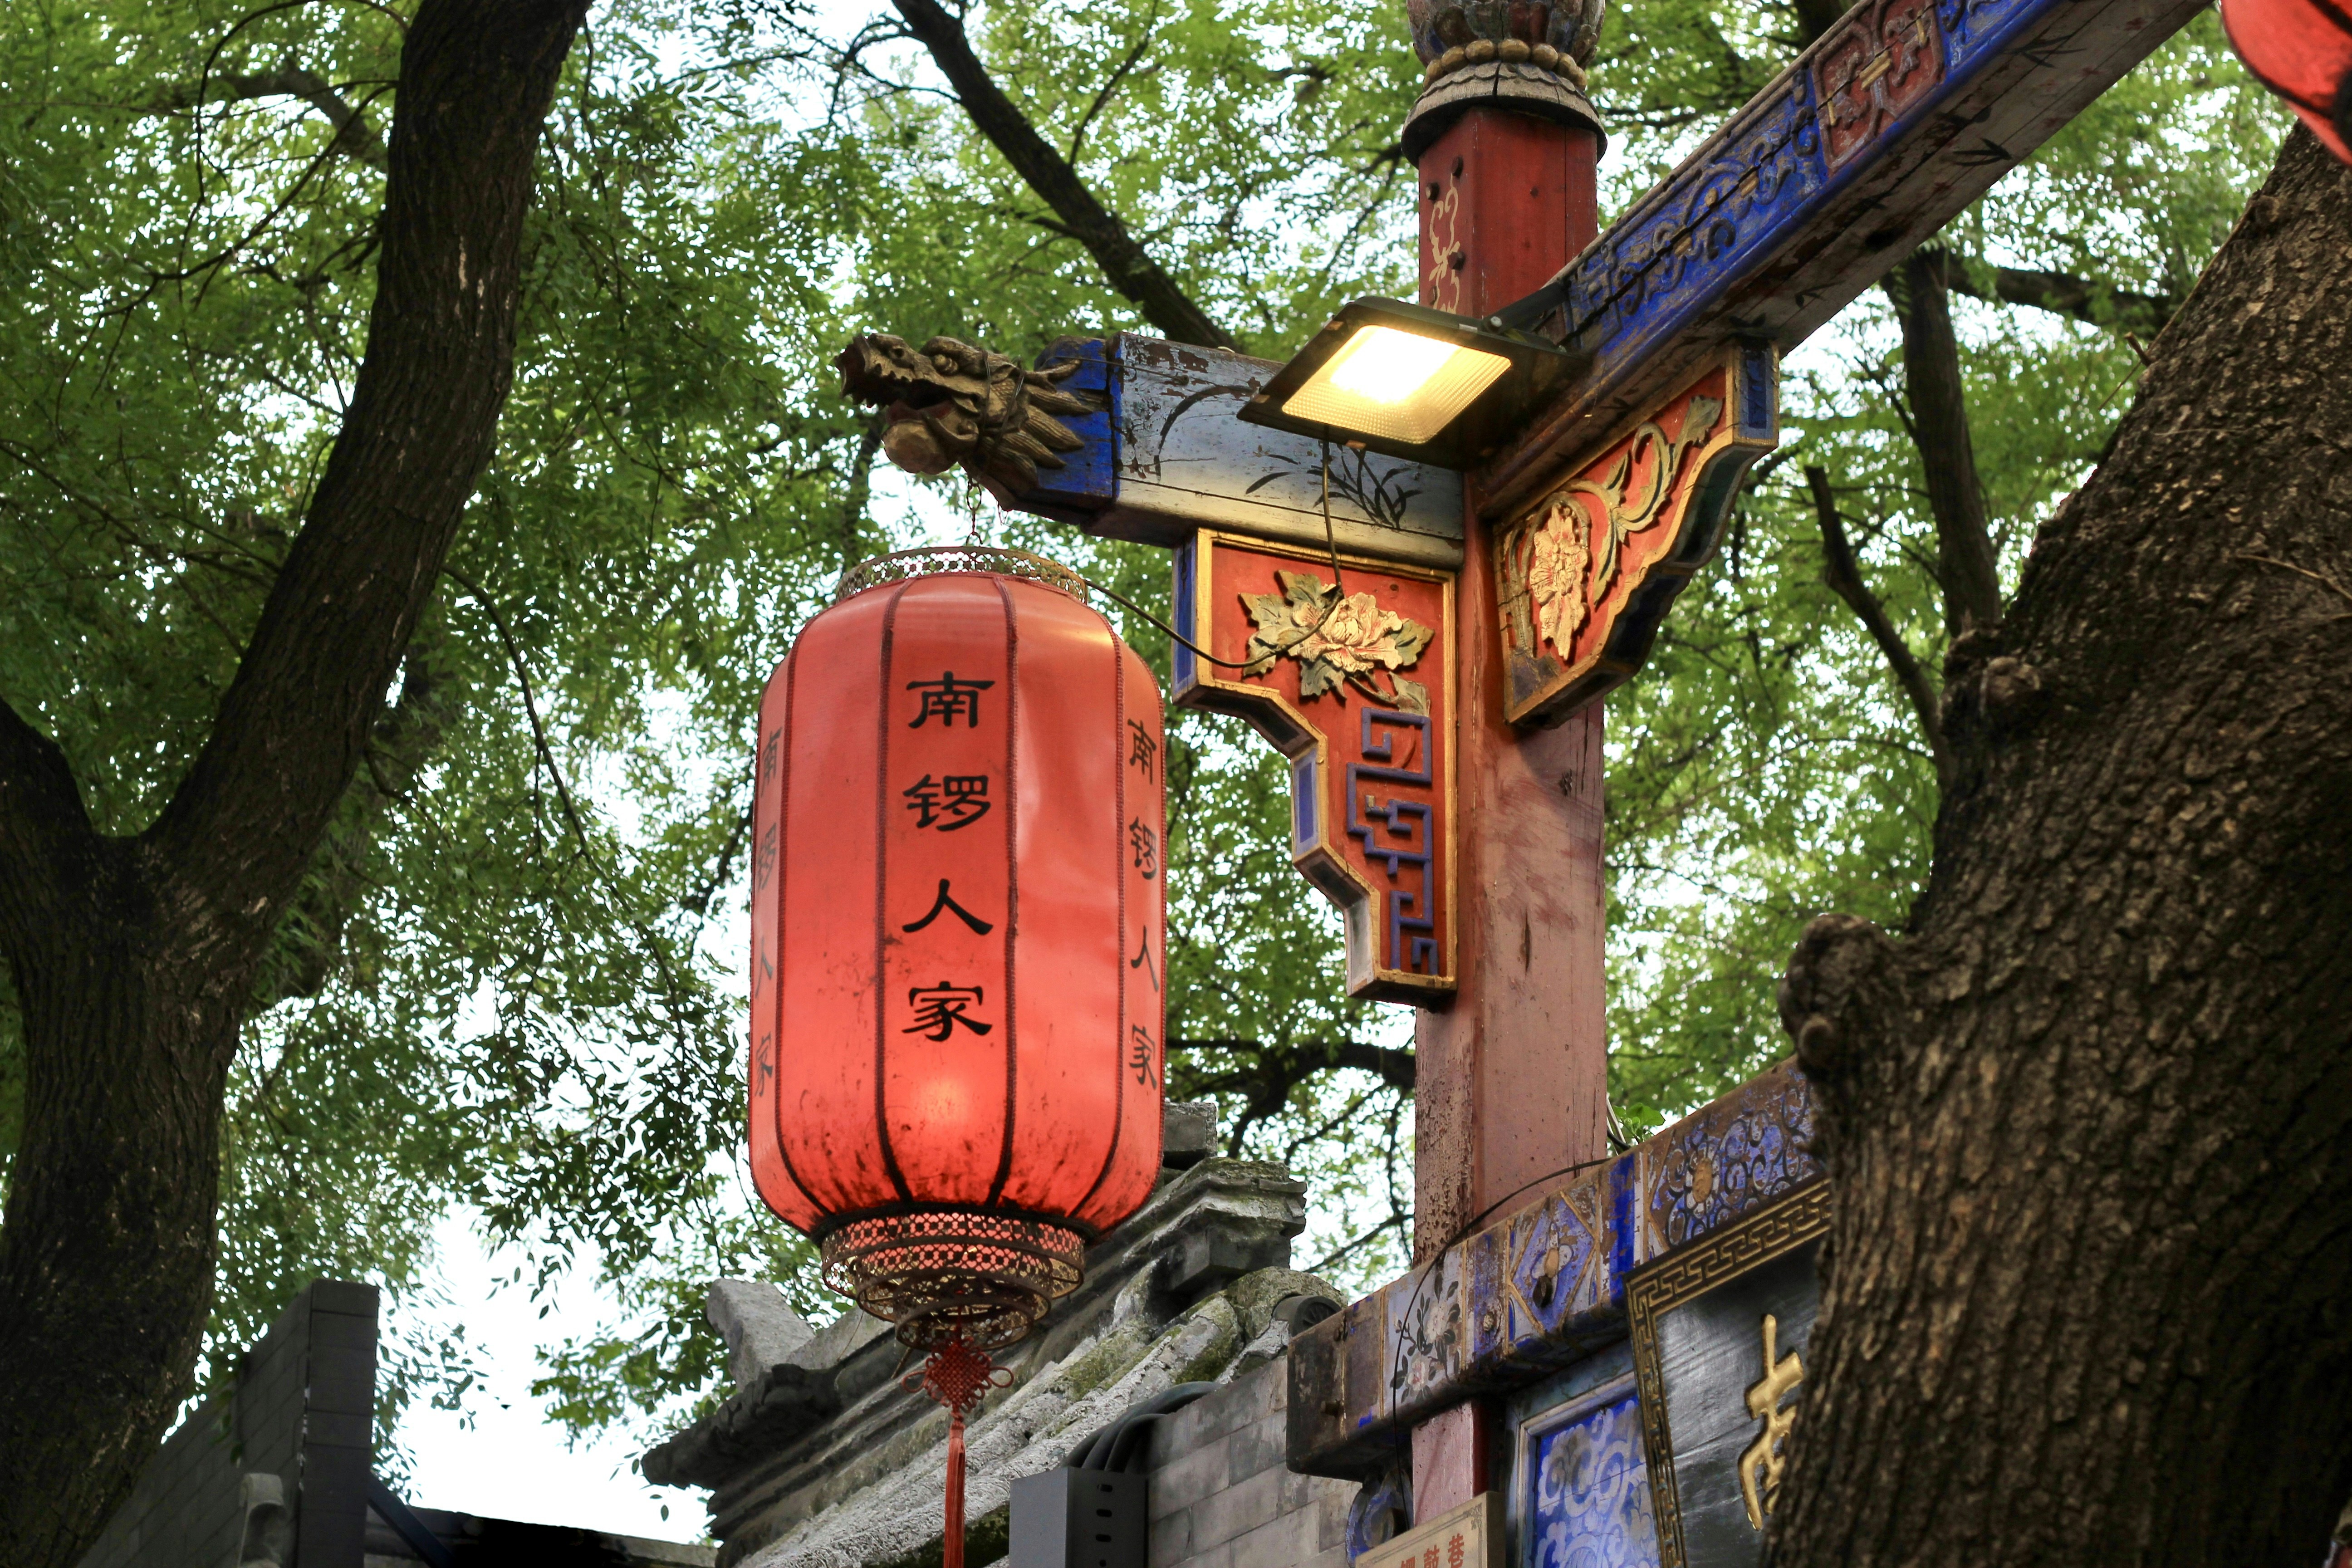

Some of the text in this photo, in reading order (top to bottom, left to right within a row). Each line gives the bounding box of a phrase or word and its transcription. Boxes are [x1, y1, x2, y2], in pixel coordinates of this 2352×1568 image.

[754, 727, 782, 1098] 南锣人家
[902, 671, 995, 1042] 南锣人家
[1127, 718, 1160, 1091] 南锣人家
